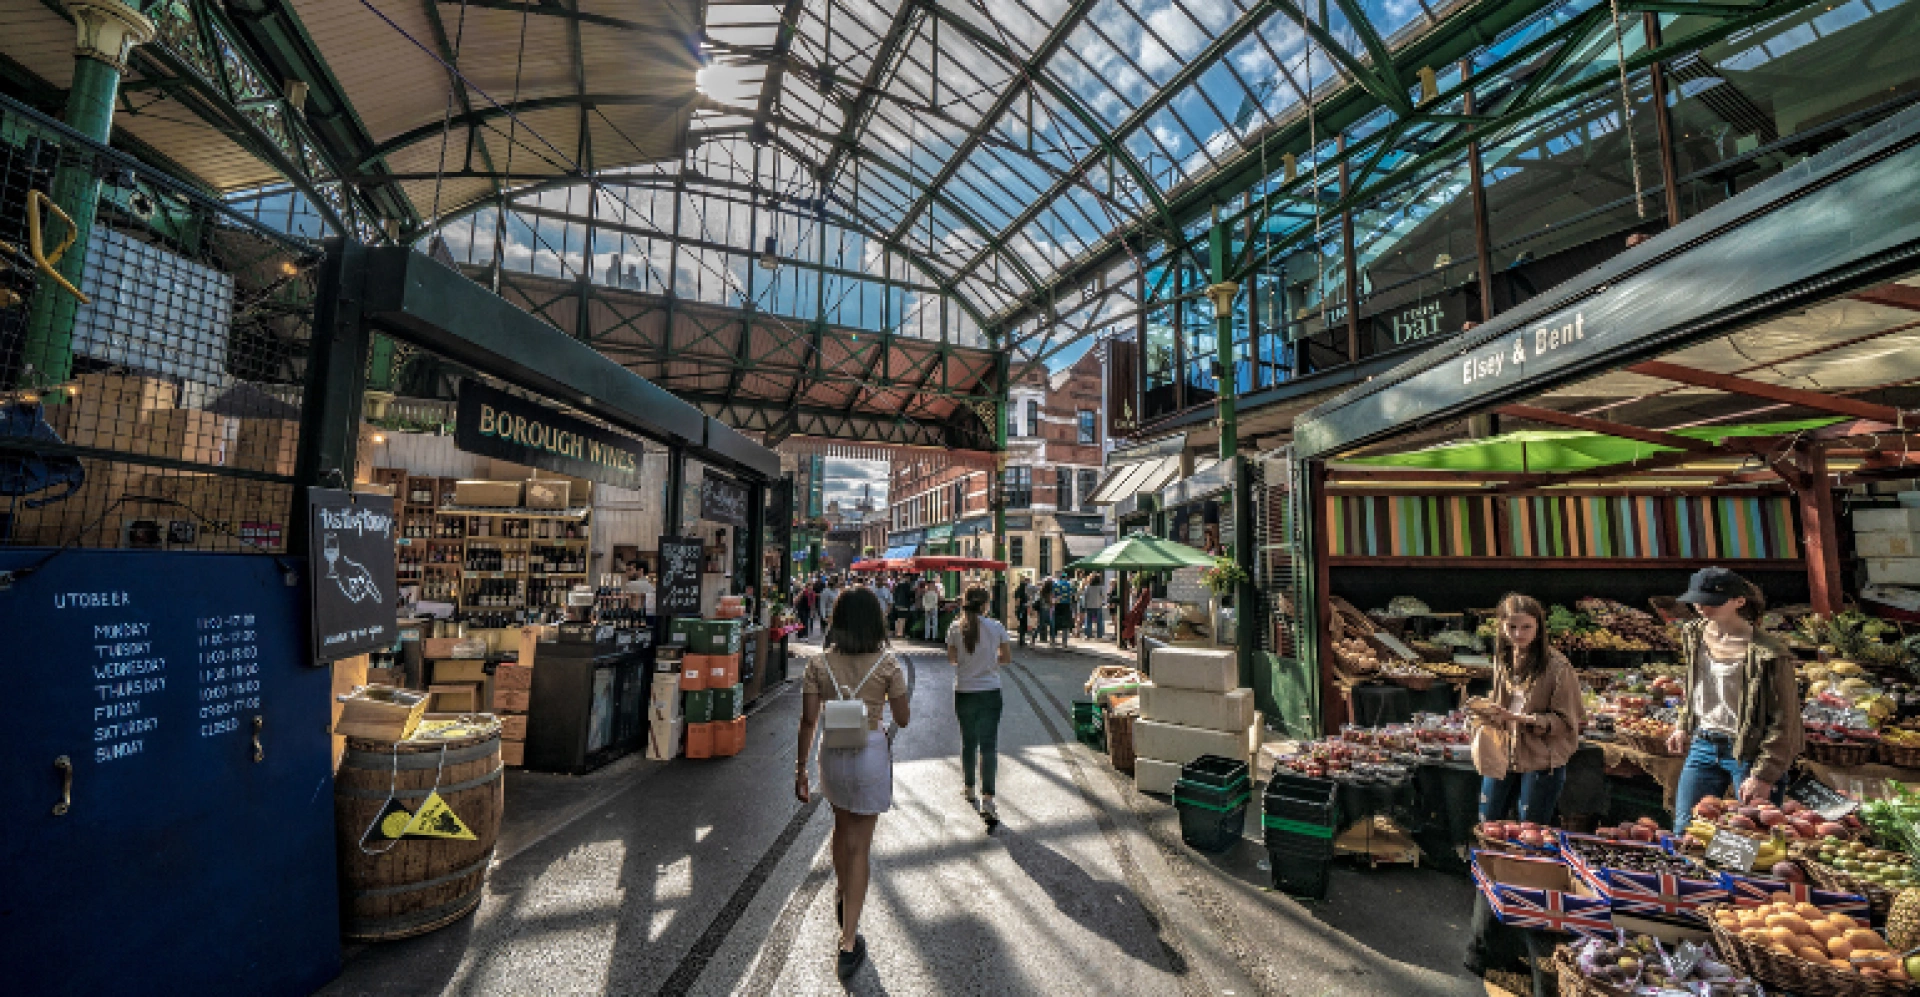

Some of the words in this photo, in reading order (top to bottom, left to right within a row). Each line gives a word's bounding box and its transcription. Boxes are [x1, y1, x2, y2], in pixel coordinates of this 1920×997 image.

[1463, 350, 1505, 384] Elsey
[1513, 338, 1526, 365] &
[1535, 313, 1584, 355] Bent
[479, 403, 582, 461] BOROUGH
[588, 438, 637, 474] WINES
[54, 591, 131, 609] UTOBEER
[94, 622, 150, 639] MONDAY
[94, 640, 152, 658] TUESDAY
[92, 657, 167, 679] WEDNESDAY
[94, 676, 167, 701] THURSDAY
[94, 700, 141, 721] FRIDAY
[94, 717, 158, 741] SATURDAY
[94, 739, 144, 764] SUNDAY
